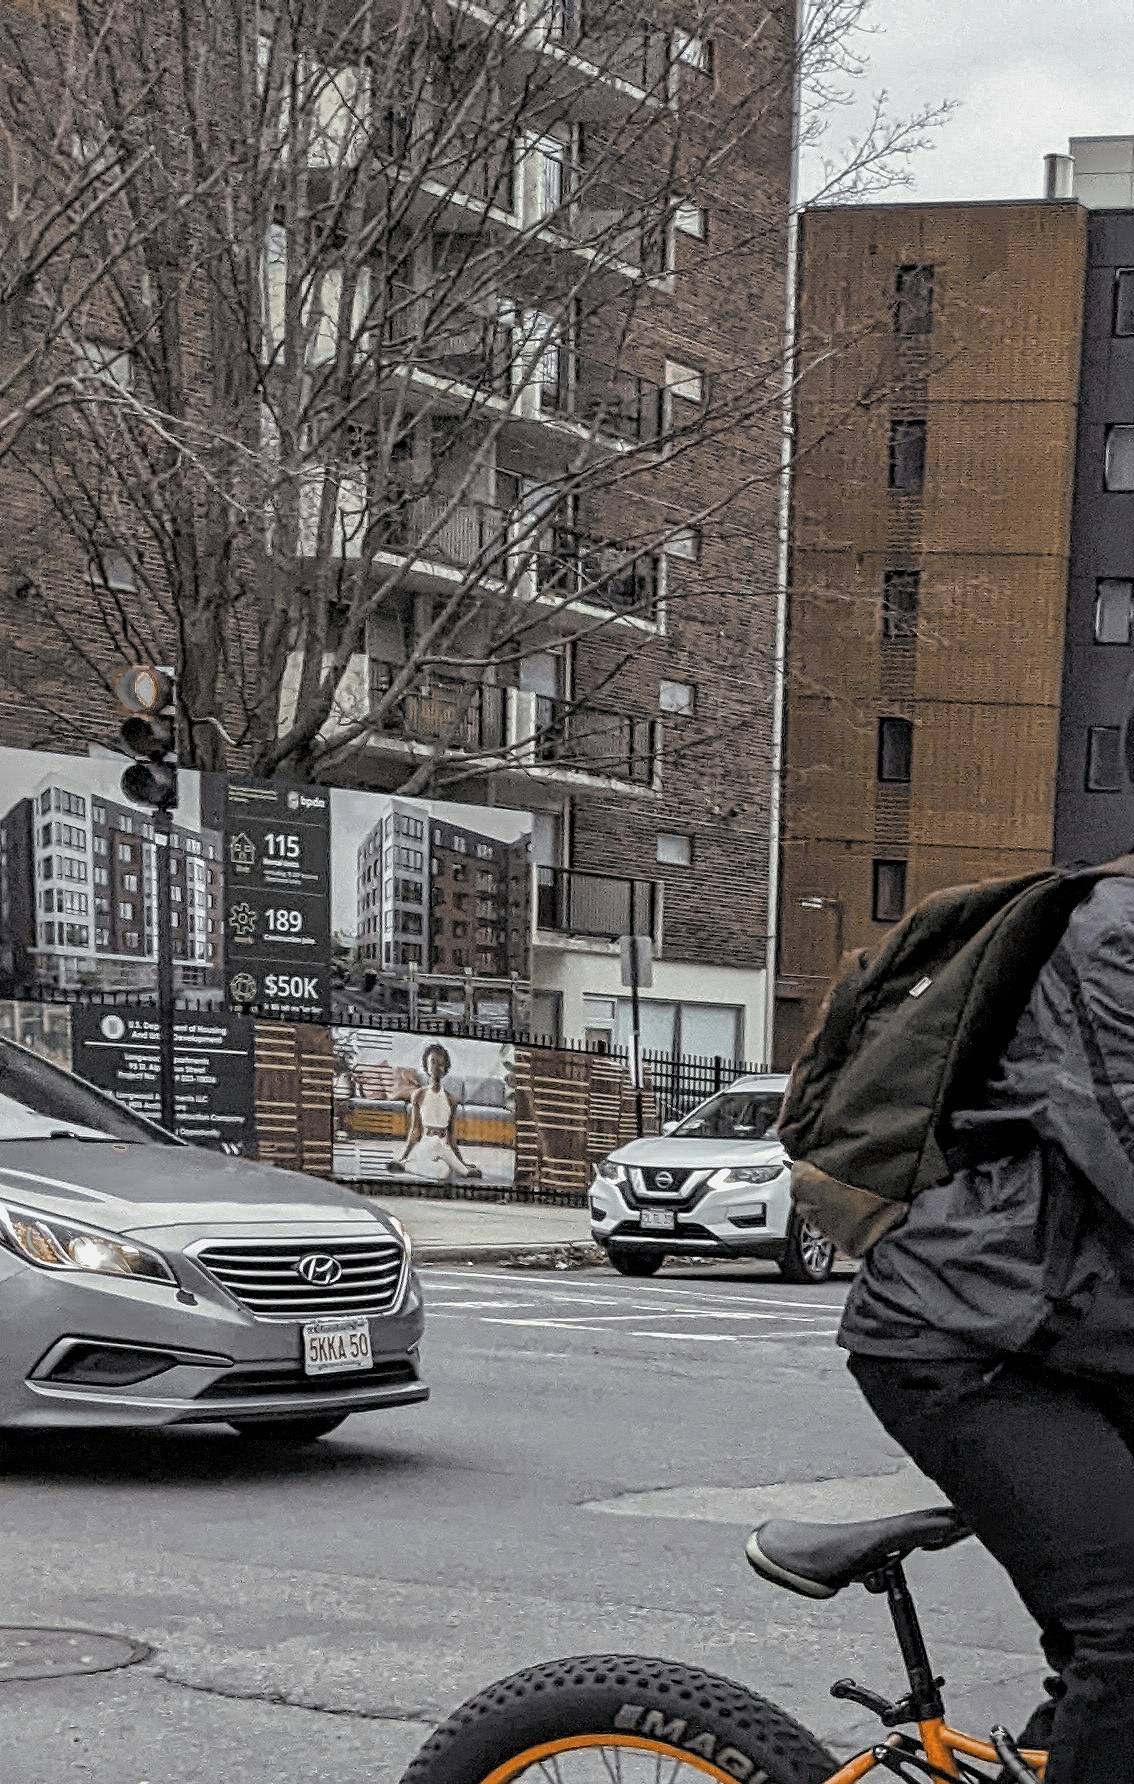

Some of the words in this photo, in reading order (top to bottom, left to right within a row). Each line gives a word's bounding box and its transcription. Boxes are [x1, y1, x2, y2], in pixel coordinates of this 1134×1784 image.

[264, 833, 300, 858] 115
[264, 908, 303, 932] 189
[264, 973, 319, 999] $50K
[309, 1335, 347, 1362] 5KKA
[350, 1333, 369, 1358] 50
